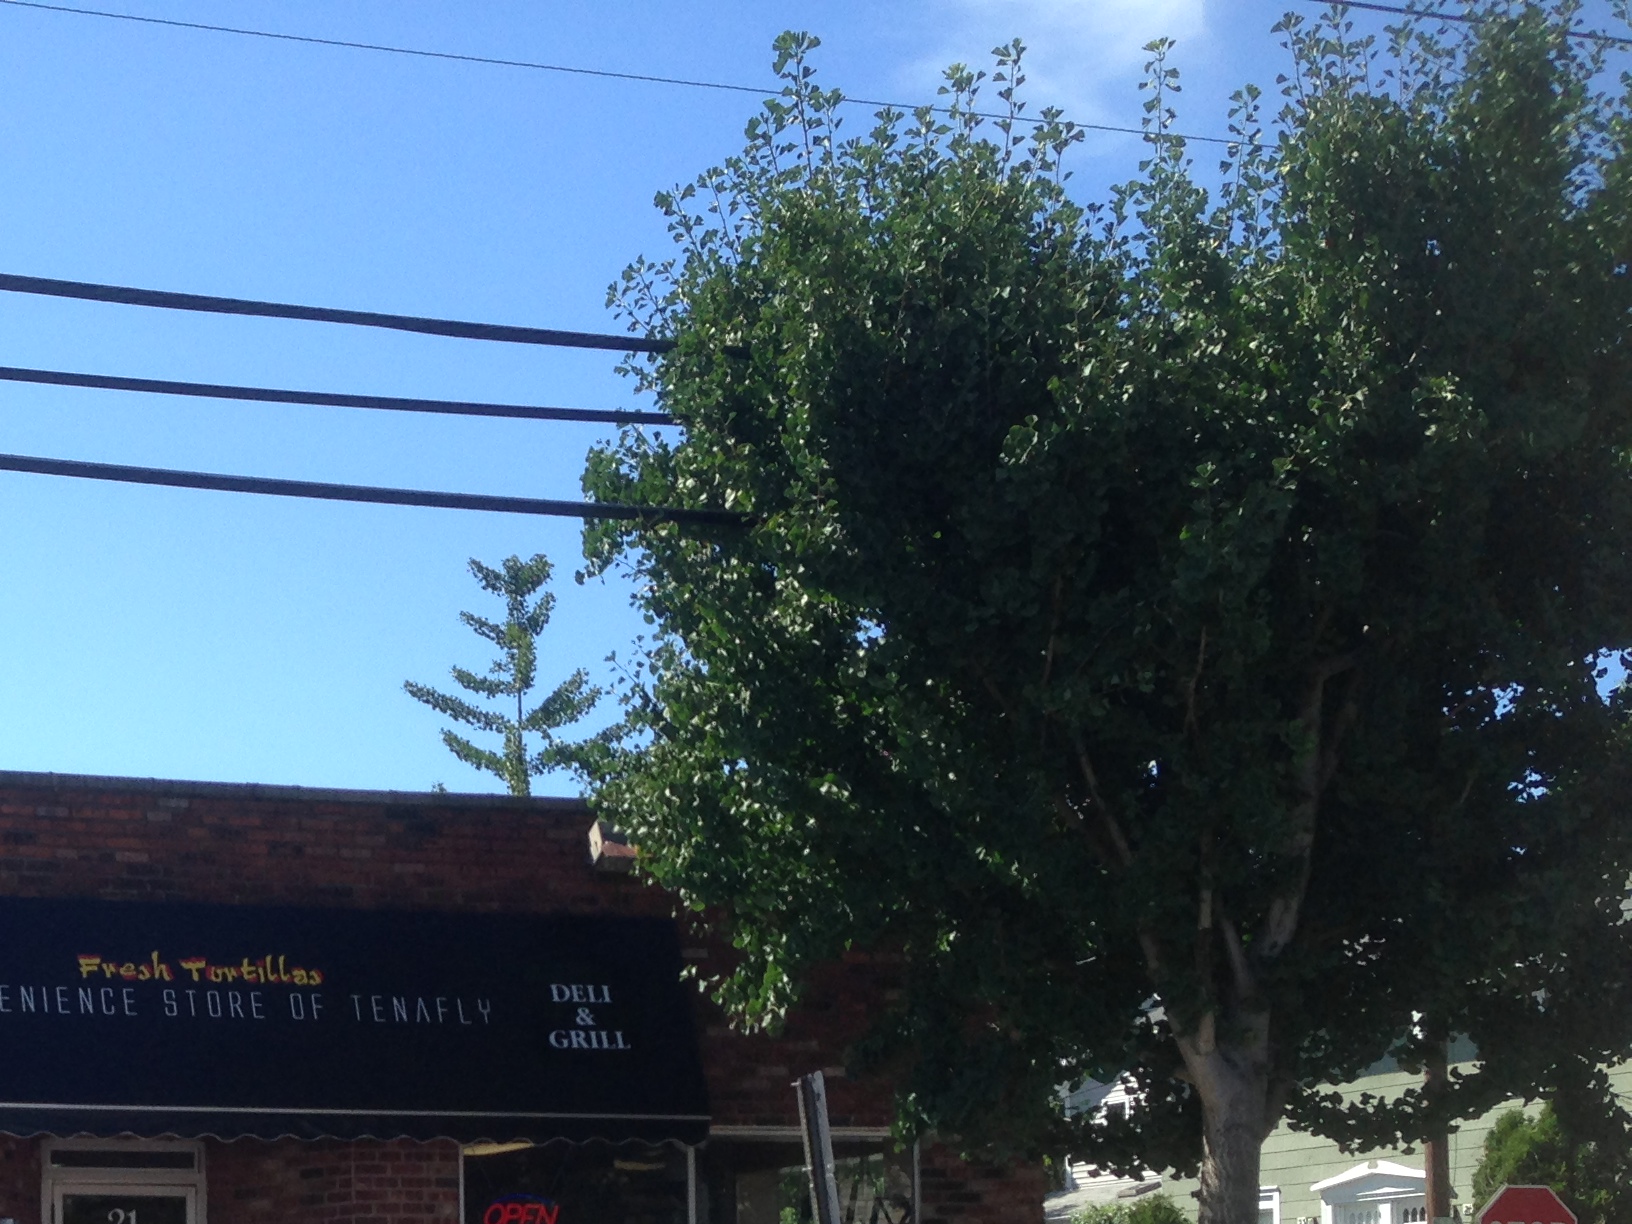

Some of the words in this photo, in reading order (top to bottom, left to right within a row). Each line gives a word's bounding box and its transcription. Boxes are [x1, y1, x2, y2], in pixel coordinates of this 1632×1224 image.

[77, 951, 173, 981] Fresh
[179, 954, 323, 985] Tortillas
[550, 983, 613, 1003] DELI
[162, 988, 265, 1019] STORE
[289, 992, 325, 1021] OF
[350, 994, 491, 1025] TENAFLY
[575, 1007, 597, 1026] &
[548, 1029, 632, 1049] GRILL
